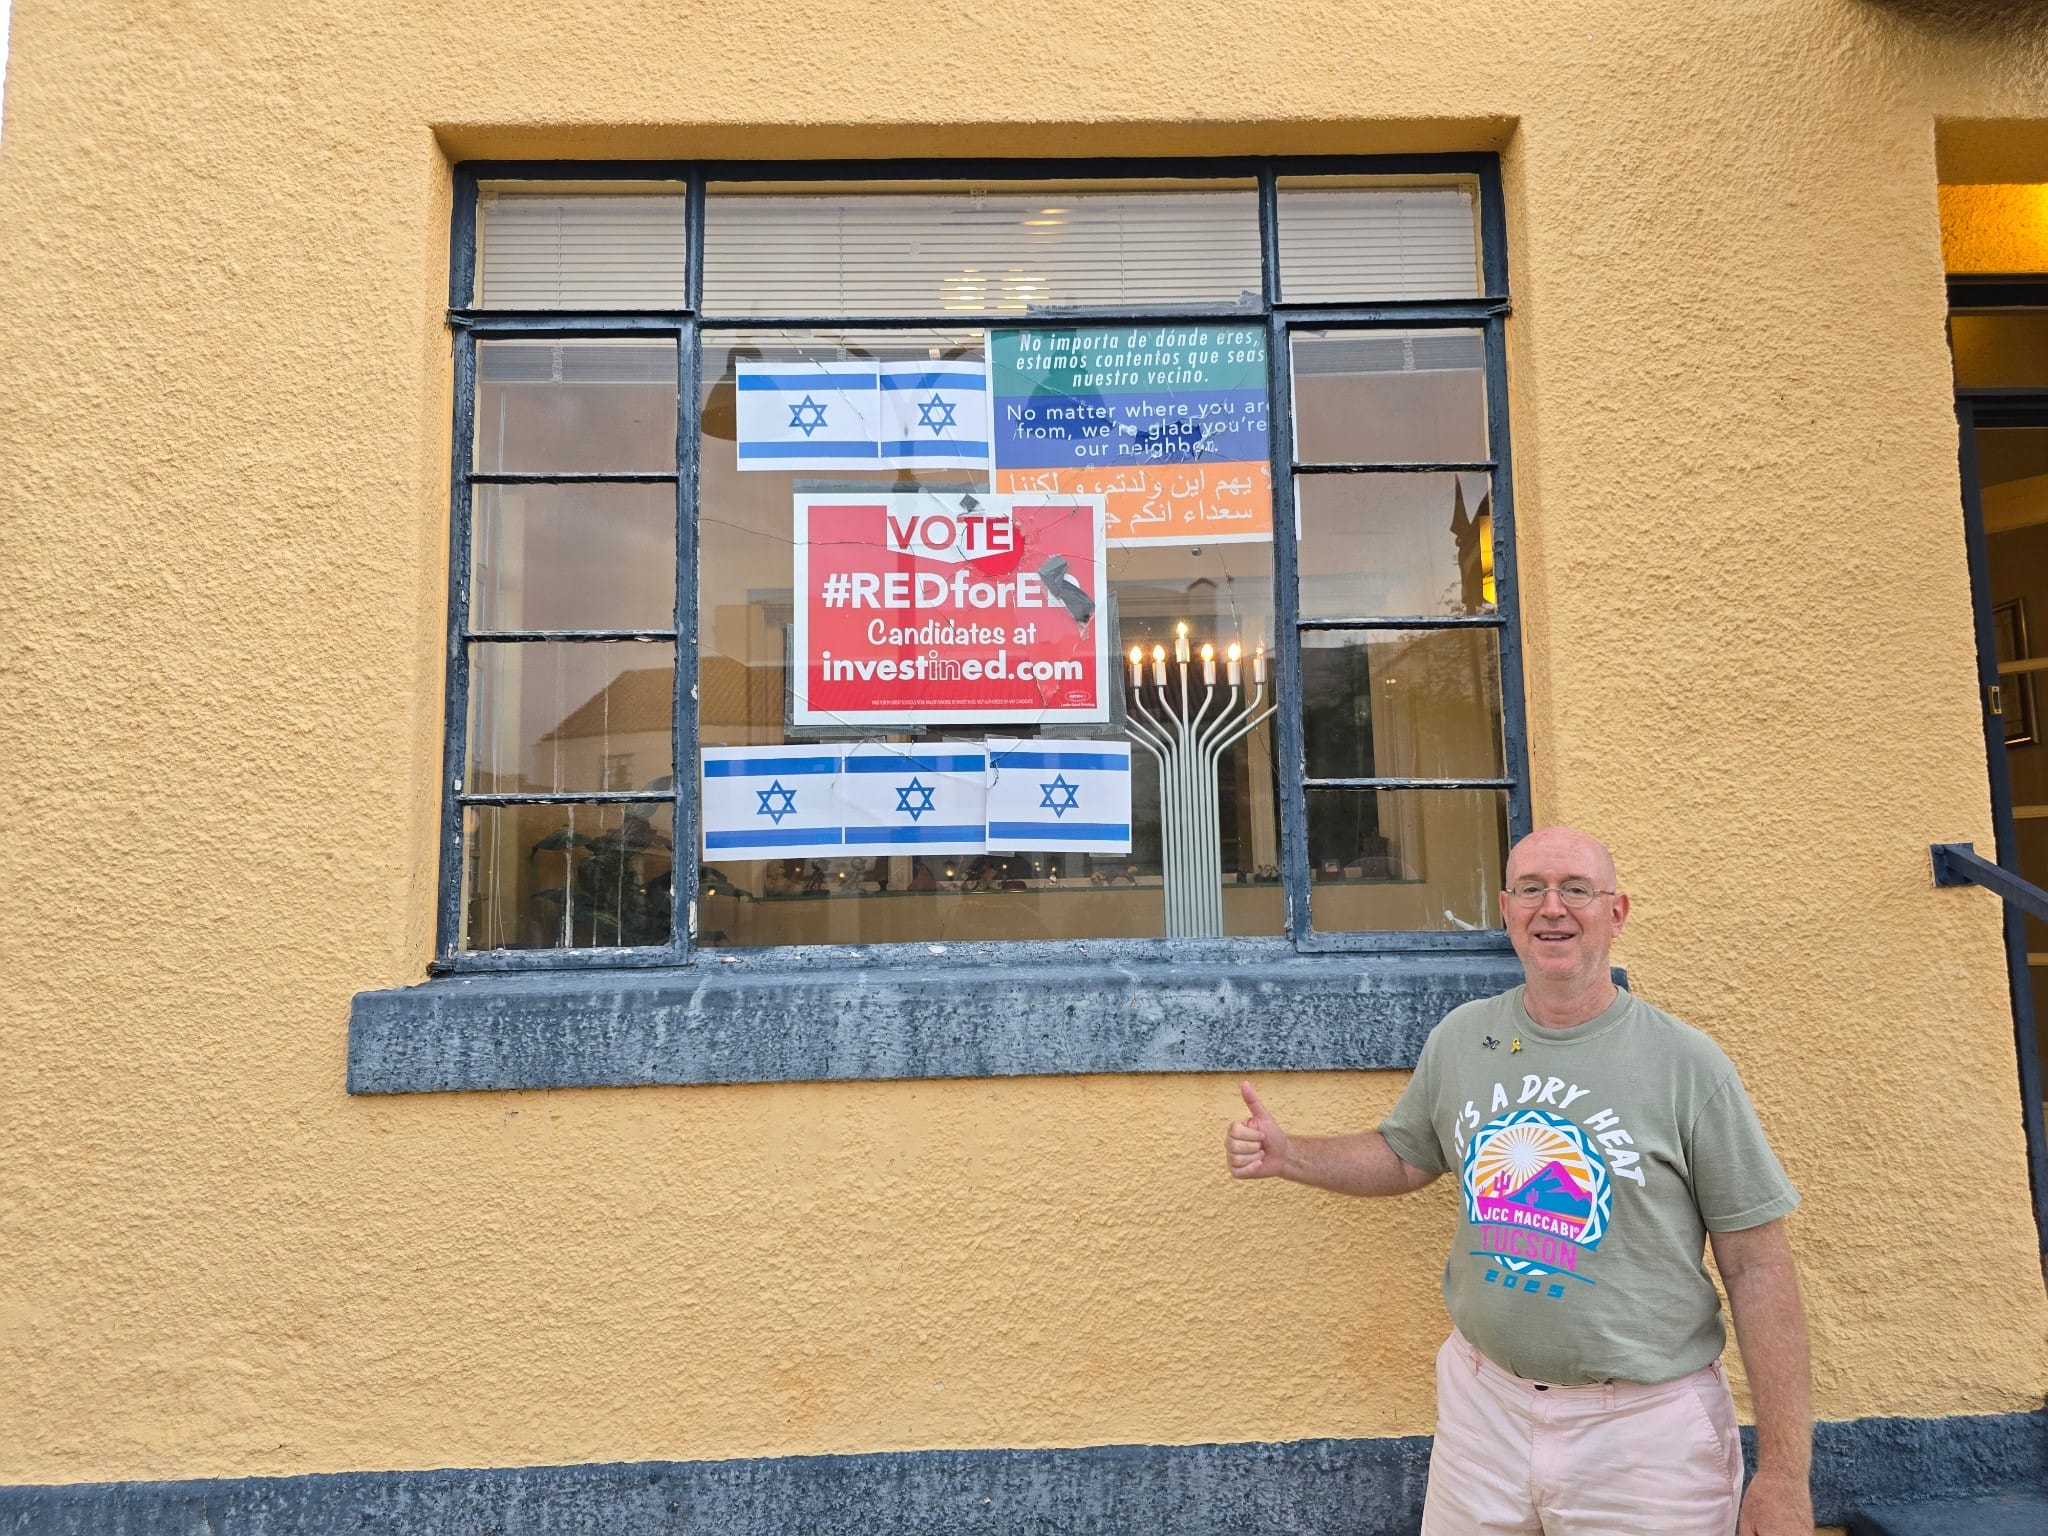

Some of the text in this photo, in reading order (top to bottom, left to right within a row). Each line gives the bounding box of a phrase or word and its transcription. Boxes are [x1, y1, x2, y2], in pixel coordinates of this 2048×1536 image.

[1019, 325, 1259, 354] No importa de dónde eres,
[1016, 346, 1265, 370] estamos contentos que seas
[1072, 369, 1209, 388] nuestro vecino.
[1007, 400, 1269, 422] No matter where you ar
[1016, 416, 1267, 441] from, we're glad you're
[1074, 440, 1109, 457] our
[887, 515, 1011, 551] VOTE
[867, 618, 1037, 646] Candidates at
[822, 649, 1084, 682] investined.com
[1491, 1082, 1509, 1113] A
[1516, 1074, 1591, 1109] DRY
[1583, 1107, 1647, 1188] HEAT
[1483, 1207, 1509, 1222] JCC
[1479, 1224, 1578, 1272] TUCSON
